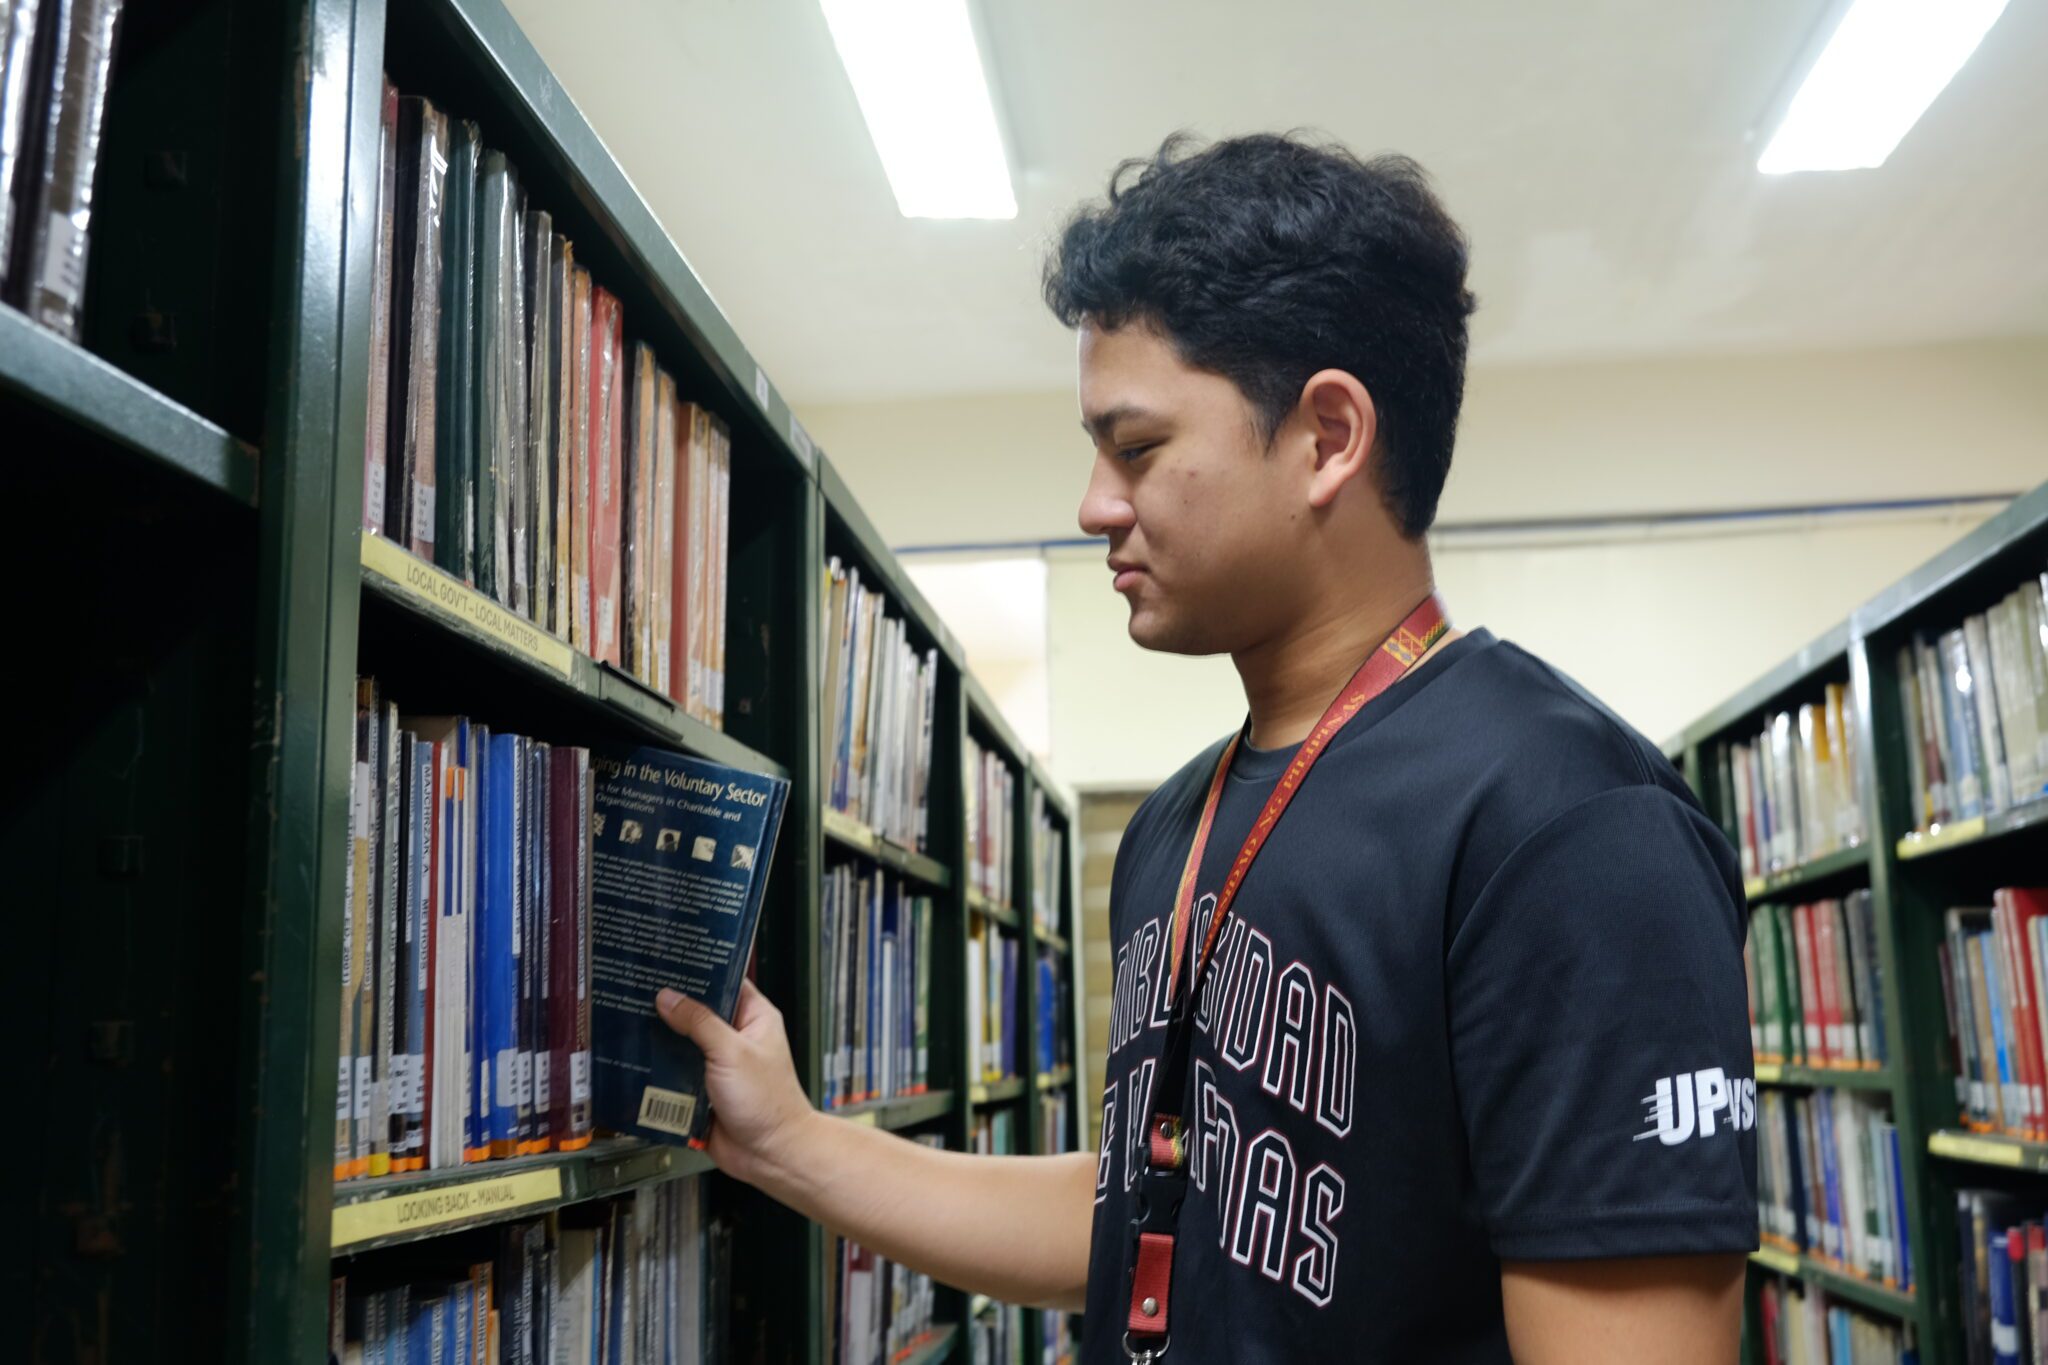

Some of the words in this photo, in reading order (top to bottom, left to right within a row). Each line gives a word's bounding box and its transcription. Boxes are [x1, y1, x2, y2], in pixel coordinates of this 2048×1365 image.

[406, 563, 438, 597] LOCAL
[440, 583, 469, 613] GOV'T
[475, 606, 503, 630] LOCAL
[503, 618, 539, 652] MATTERS
[607, 784, 619, 796] for
[621, 786, 664, 807] Managers
[665, 797, 675, 806] in
[676, 799, 721, 818] Charitable
[722, 811, 742, 822] and
[624, 760, 636, 777] in
[640, 764, 660, 783] the
[664, 769, 725, 801] Voluntary
[725, 783, 768, 807] Sector
[397, 1199, 444, 1223] LOOKING
[446, 1192, 471, 1213] BACK
[478, 1183, 516, 1208] MANUAL
